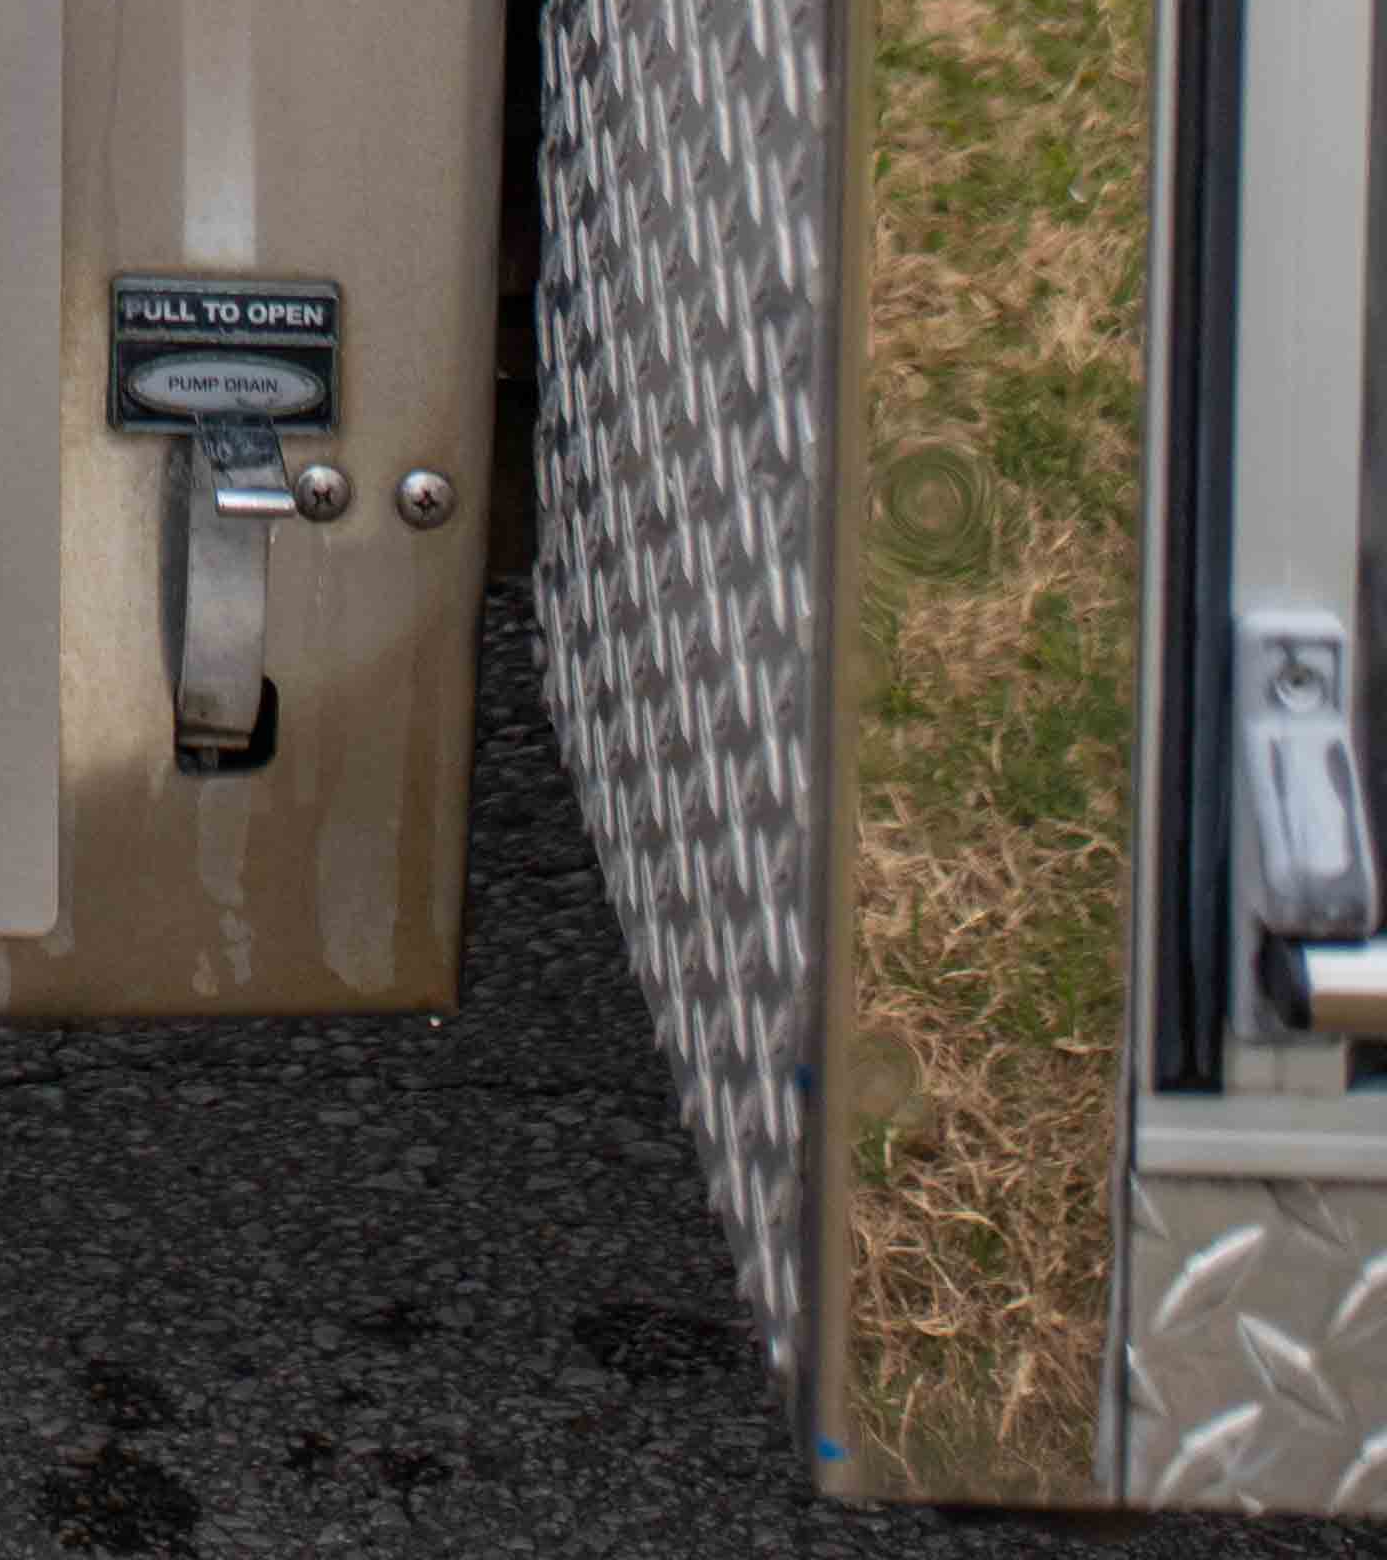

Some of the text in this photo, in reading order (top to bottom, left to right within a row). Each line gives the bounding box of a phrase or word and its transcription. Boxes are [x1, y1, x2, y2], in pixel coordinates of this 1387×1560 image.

[126, 298, 324, 326] PULL TO OPEN
[168, 377, 278, 393] PUMP DRAIN
